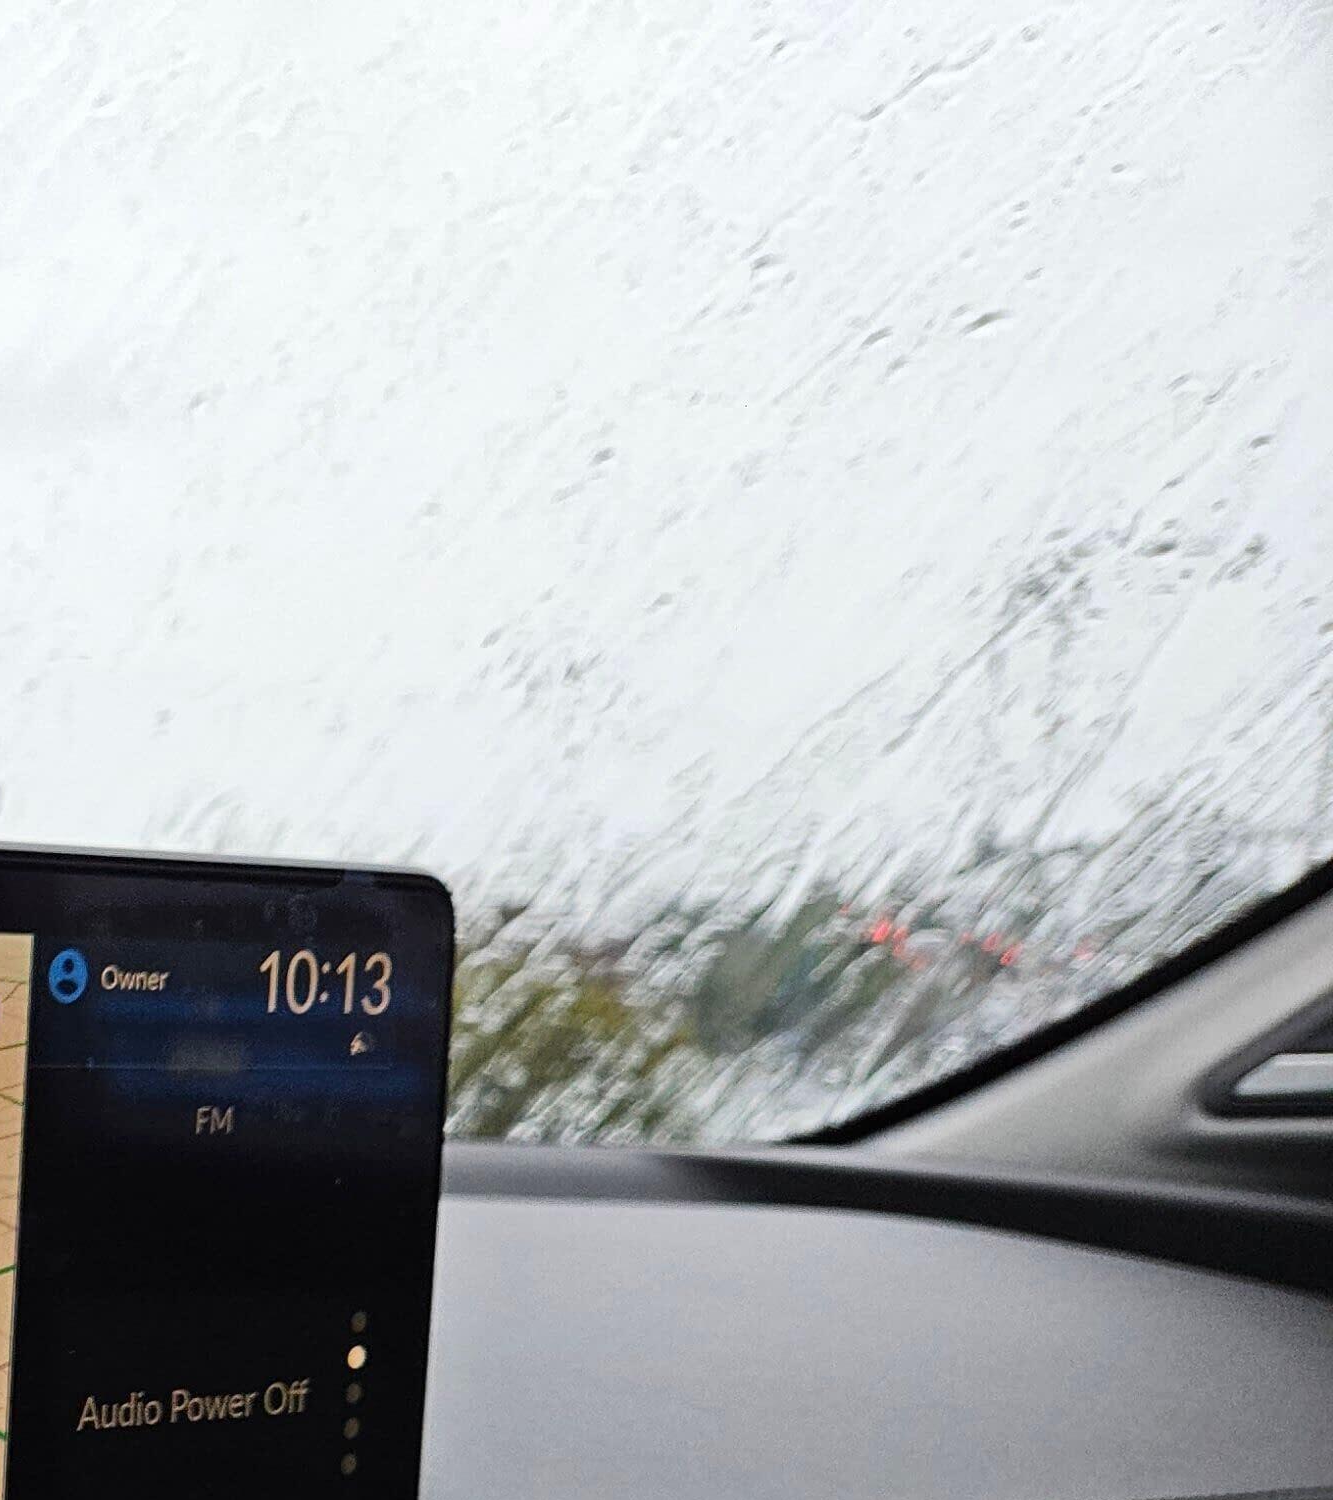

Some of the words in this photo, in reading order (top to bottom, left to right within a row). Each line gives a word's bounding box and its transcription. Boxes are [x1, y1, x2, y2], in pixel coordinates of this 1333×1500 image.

[100, 964, 171, 992] Owner
[258, 949, 393, 1017] 10:13
[195, 1106, 233, 1136] FM
[77, 1391, 163, 1432] Audio
[170, 1389, 256, 1423] Power
[263, 1377, 311, 1417] Off
